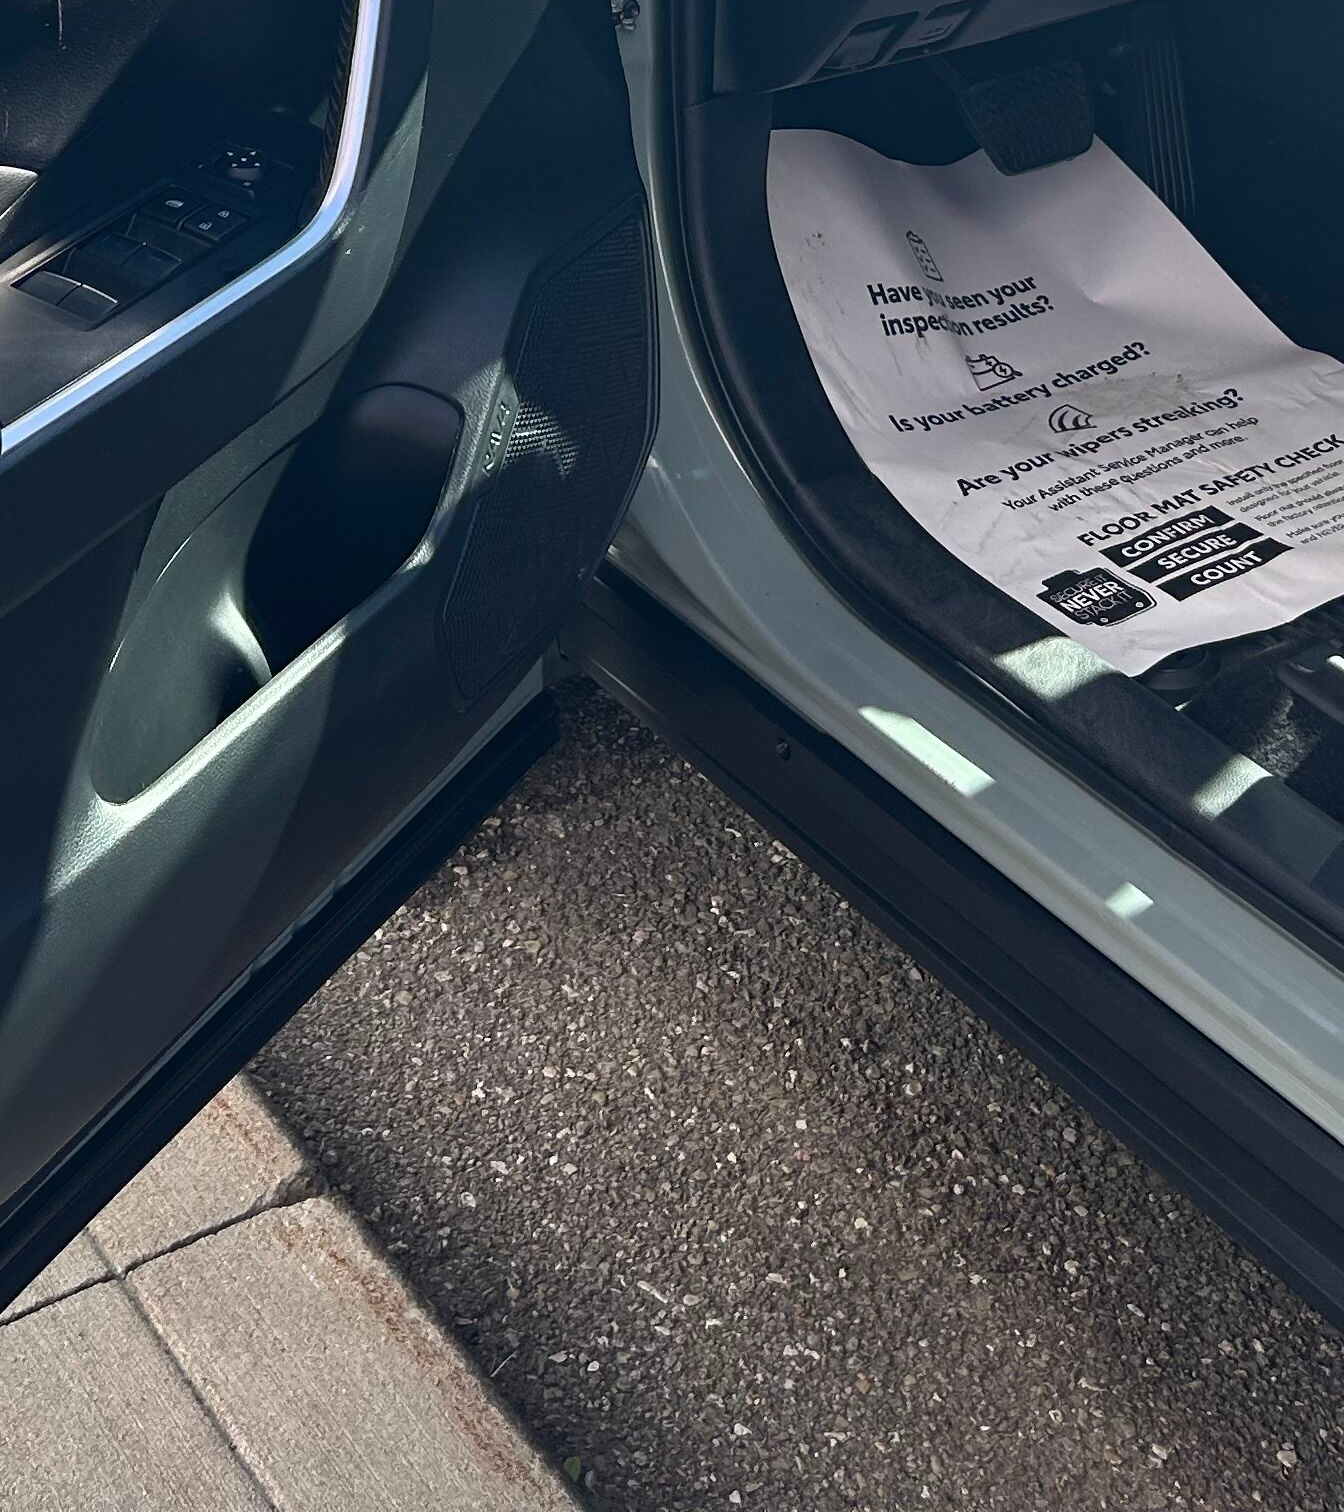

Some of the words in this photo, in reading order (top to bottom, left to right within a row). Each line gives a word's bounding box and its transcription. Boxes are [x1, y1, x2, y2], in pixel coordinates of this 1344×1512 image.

[867, 283, 923, 306] Have
[947, 292, 989, 310] seen
[987, 276, 1037, 306] your
[972, 294, 1054, 334] results?
[888, 414, 915, 432] Is
[913, 406, 966, 432] your
[962, 383, 1053, 416] battery
[1052, 341, 1150, 389] charged?
[956, 473, 1003, 497] Are
[999, 452, 1056, 481] your
[1056, 426, 1133, 459] wipers
[1132, 388, 1244, 433] streaking?
[1001, 493, 1038, 511] Your
[1037, 468, 1102, 500] Assistant
[1098, 453, 1148, 473] Service
[1144, 432, 1206, 458] Manager
[1204, 424, 1231, 438] can
[1225, 415, 1260, 432] help
[1048, 492, 1083, 512] with
[1079, 476, 1121, 498] these
[1119, 454, 1185, 485] questions
[1182, 443, 1210, 460] and
[1208, 435, 1249, 450] more.
[1076, 511, 1159, 547] FLOOR
[1150, 488, 1203, 518] MAT
[1198, 462, 1276, 496] SAFETY
[1120, 514, 1216, 559] CONFIRM
[1157, 533, 1239, 570] SECURE
[1049, 577, 1095, 603] SECURE
[1093, 573, 1108, 584] IT
[1190, 550, 1264, 587] COUNT
[1059, 581, 1125, 613] NEVER
[1073, 595, 1120, 621] STACK
[1117, 589, 1134, 602] IT
